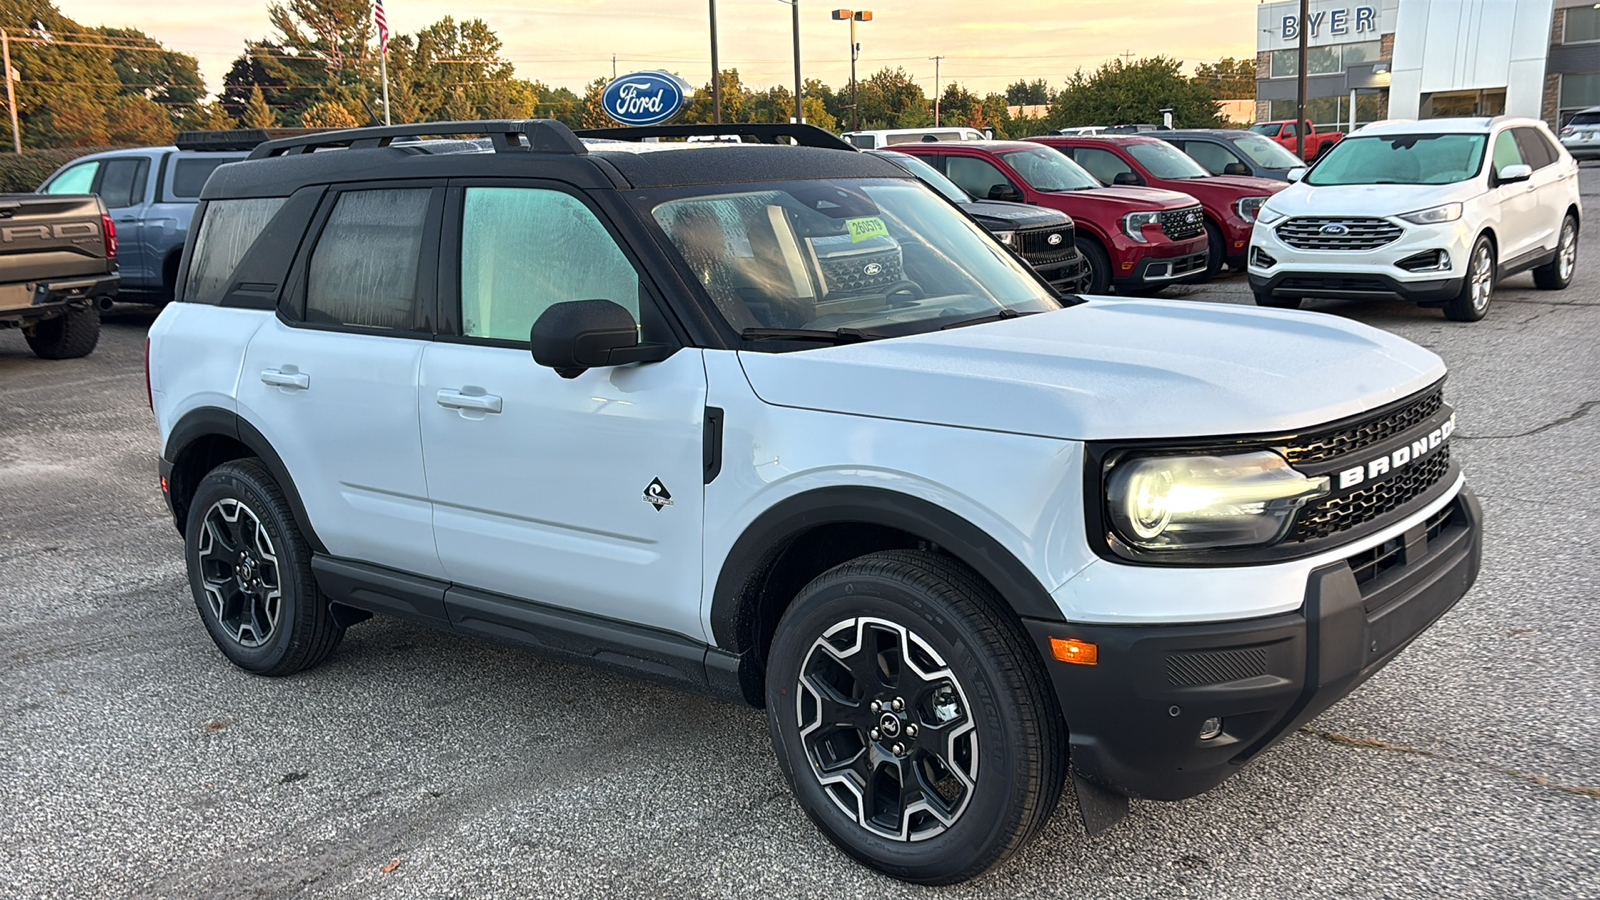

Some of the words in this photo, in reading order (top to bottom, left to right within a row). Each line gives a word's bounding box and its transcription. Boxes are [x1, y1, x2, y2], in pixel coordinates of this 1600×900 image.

[1282, 7, 1374, 39] BYER
[616, 83, 664, 114] Ford
[852, 219, 883, 236] 260579
[1340, 412, 1456, 489] BRONCO
